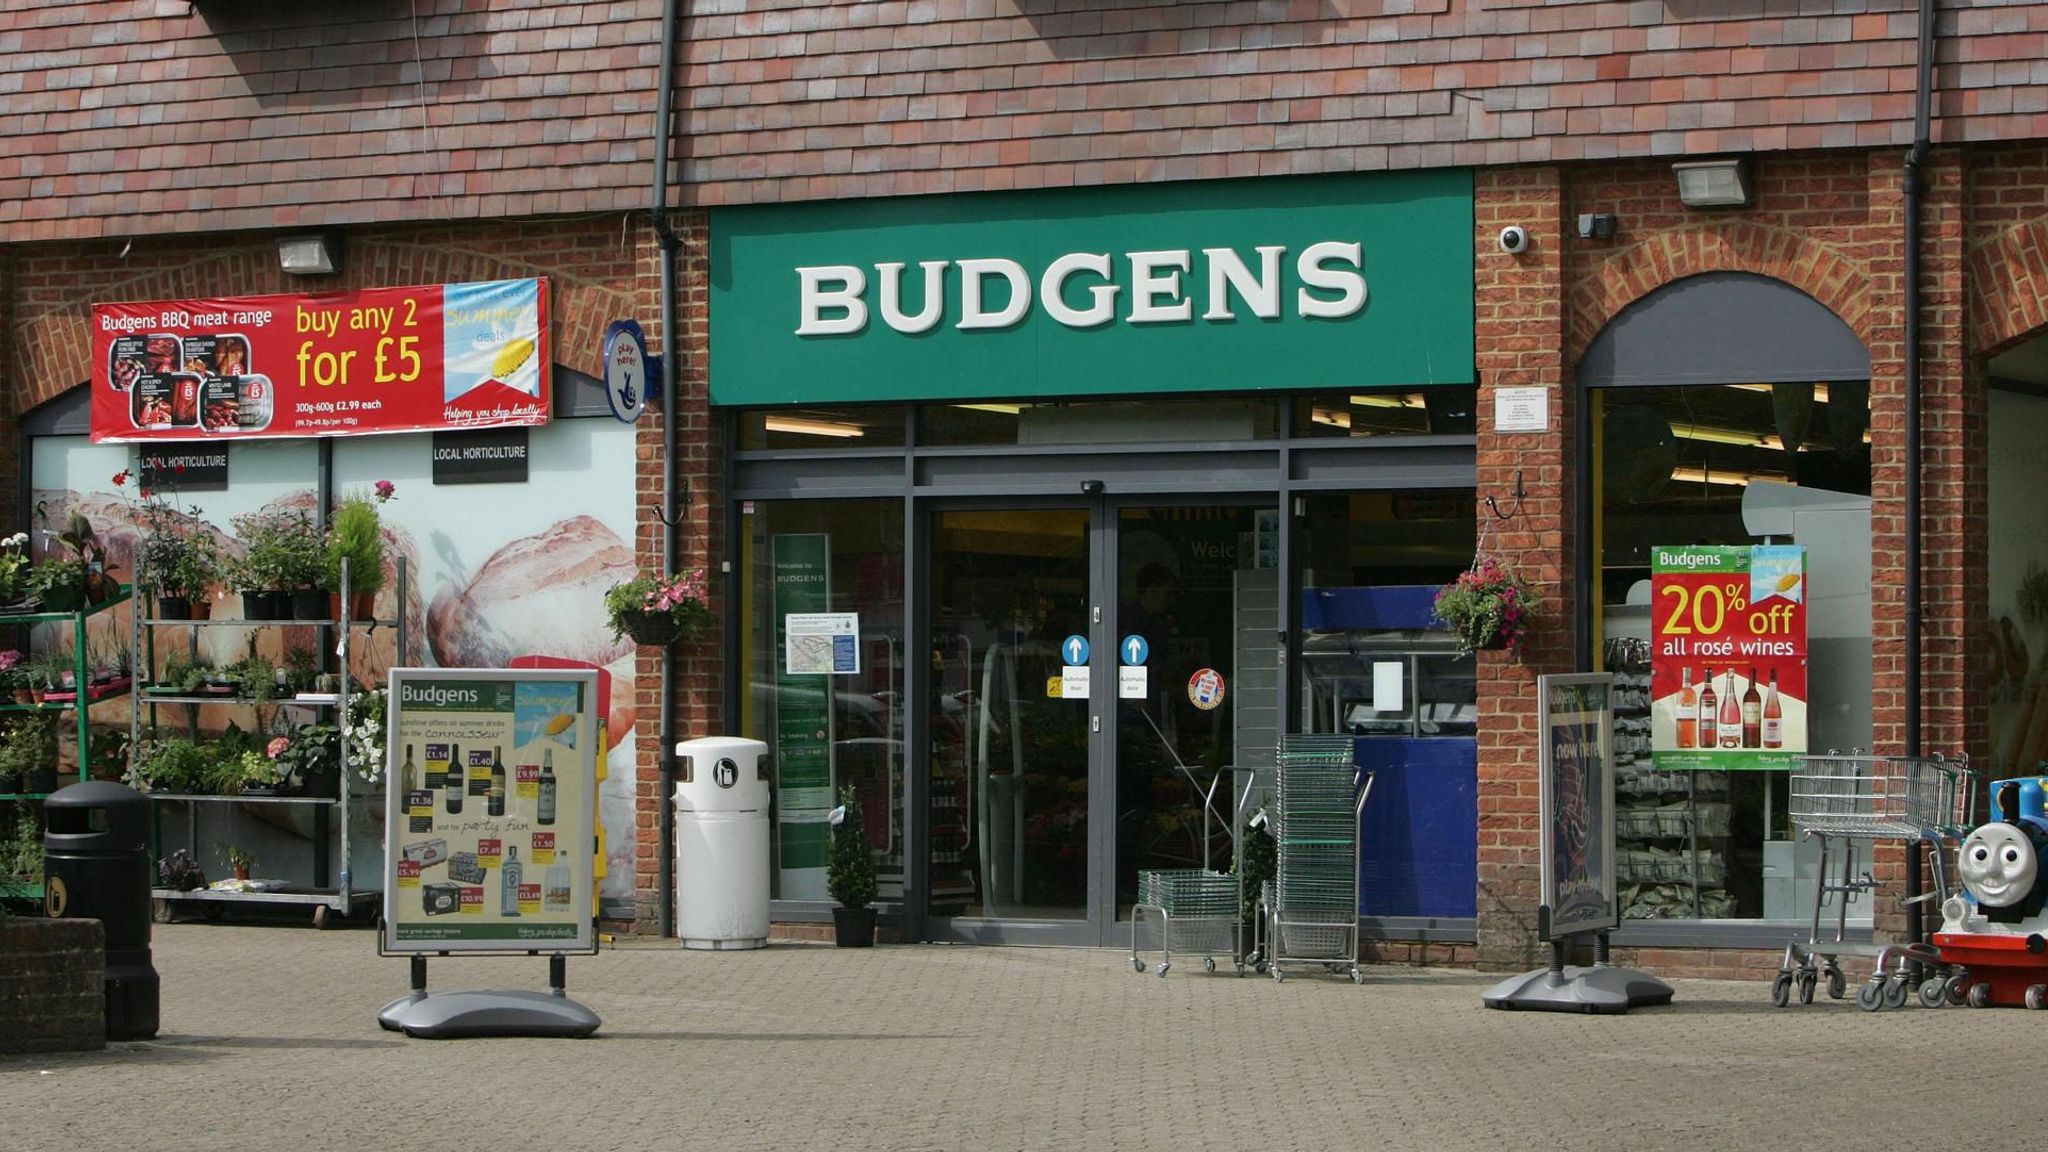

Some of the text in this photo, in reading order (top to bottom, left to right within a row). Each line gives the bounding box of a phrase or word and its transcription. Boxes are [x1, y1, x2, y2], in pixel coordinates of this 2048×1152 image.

[793, 240, 1368, 336] BUDGENS
[102, 310, 272, 333] Budgens BBQ meat range
[296, 298, 418, 338] buy any 2
[476, 330, 505, 343] deals
[617, 343, 634, 354] play
[296, 336, 421, 387] for £5
[295, 399, 382, 414] 300g-600g £2.99 each
[444, 403, 540, 424] Helping you shop locally
[168, 454, 226, 468] HORTICULTURE
[434, 446, 526, 460] LOCAL HORTICULTURE
[1190, 540, 1237, 558] Welc
[1659, 551, 1721, 569] Budgens
[777, 574, 825, 583] BUDGENS
[1661, 583, 1796, 635] 20% off
[1663, 636, 1794, 656] all rosé wines
[402, 685, 478, 707] Budgens
[426, 751, 448, 759] £1.14
[1556, 743, 1578, 760] now
[469, 757, 492, 765] £1.40
[517, 770, 539, 778] £9.99
[411, 797, 433, 805] £1.36
[460, 820, 499, 838] party
[505, 818, 530, 832] fun
[533, 840, 554, 848] £1.50
[398, 868, 419, 876] £5.99
